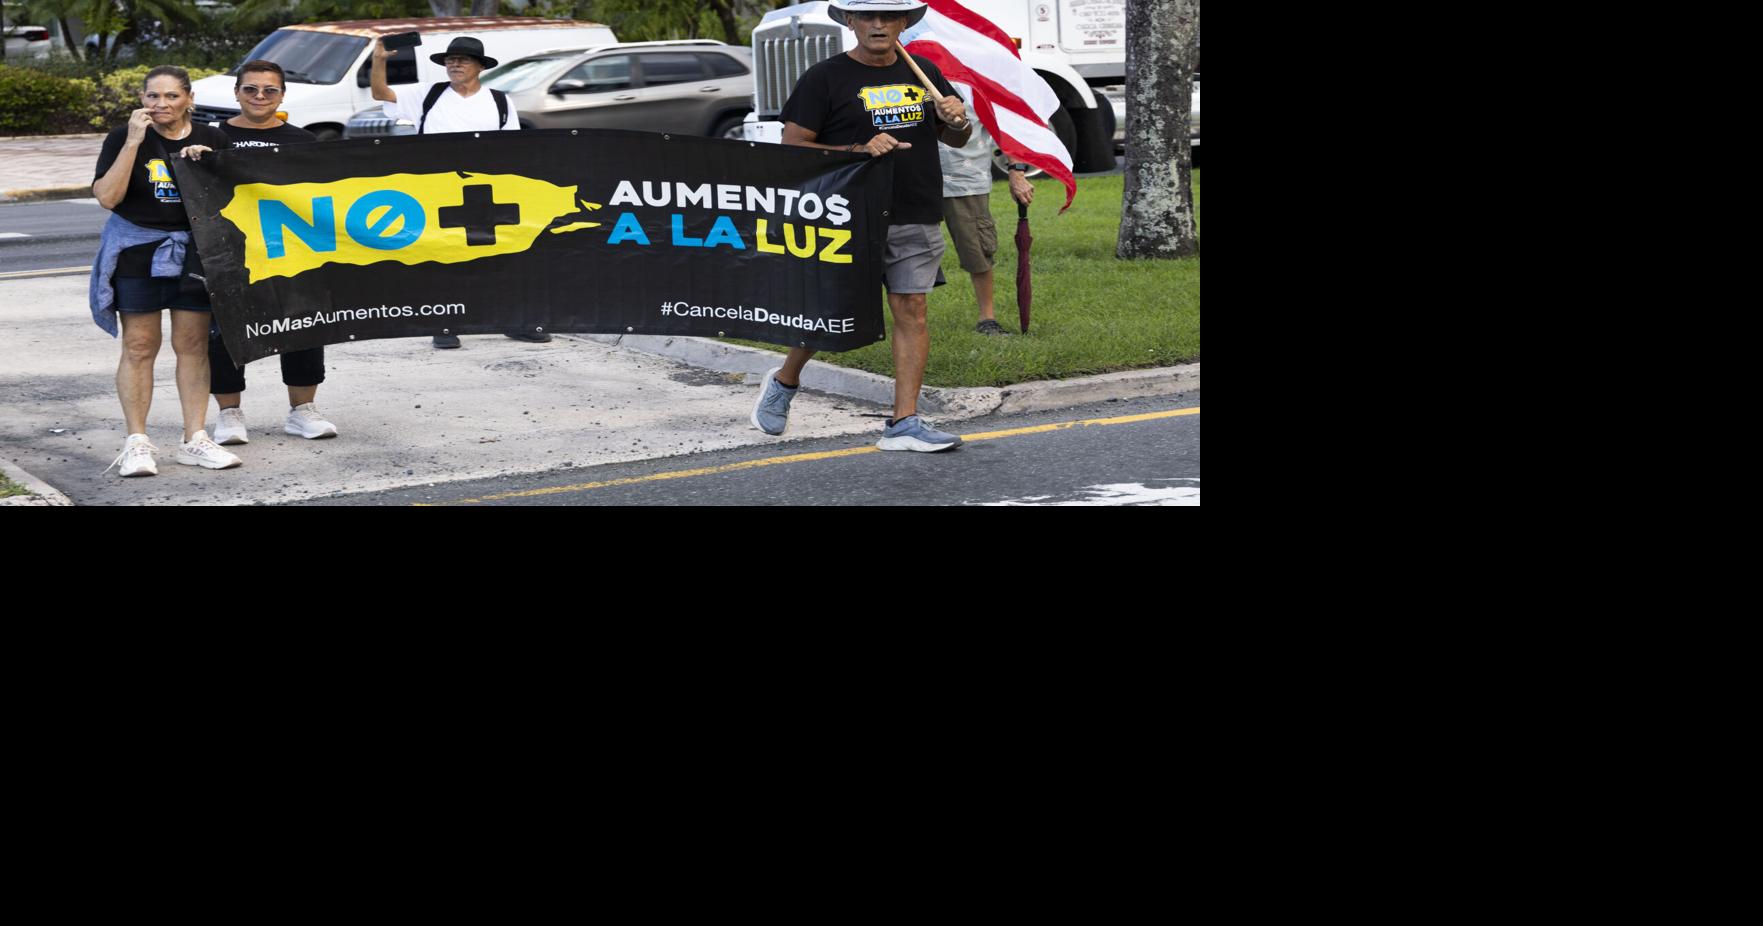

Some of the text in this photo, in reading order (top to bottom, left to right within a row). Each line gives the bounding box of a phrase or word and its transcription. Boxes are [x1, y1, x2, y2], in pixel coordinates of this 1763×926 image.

[874, 112, 922, 124] A LA LUZ
[607, 212, 853, 264] A LA LUZ
[246, 303, 466, 338] NoMasAumentos.com
[661, 301, 855, 333] #CancelaDeudaAEE
